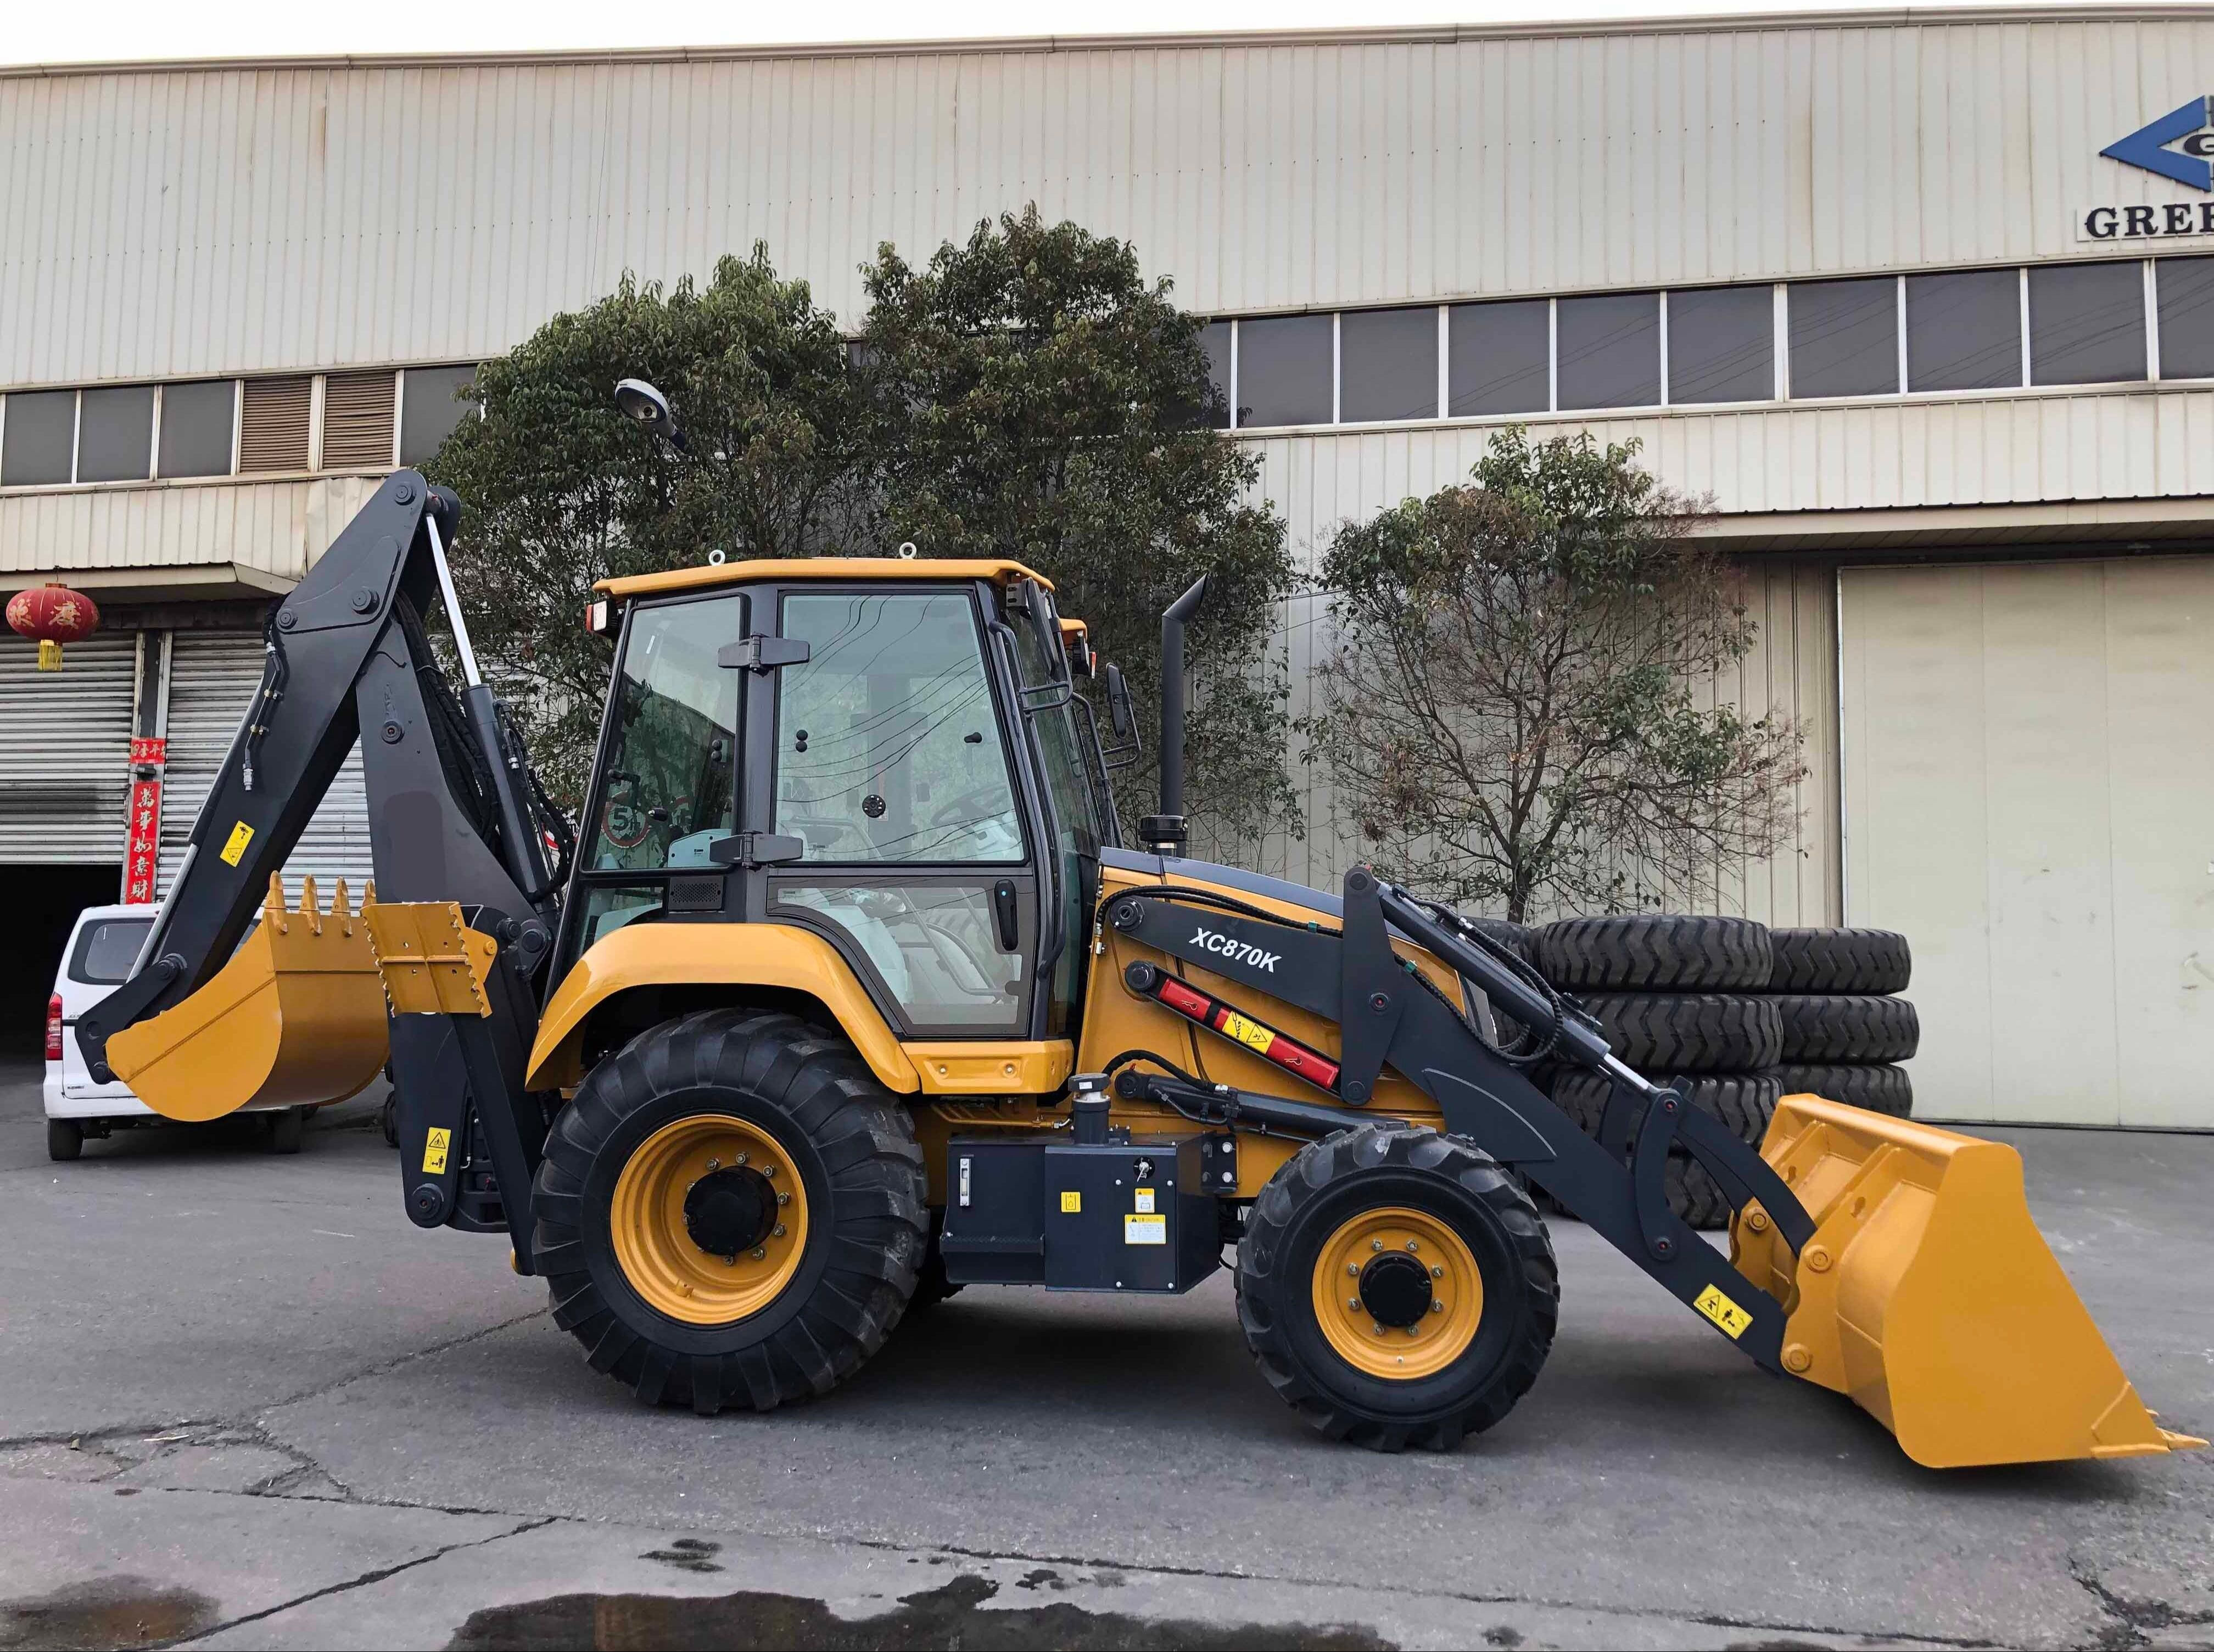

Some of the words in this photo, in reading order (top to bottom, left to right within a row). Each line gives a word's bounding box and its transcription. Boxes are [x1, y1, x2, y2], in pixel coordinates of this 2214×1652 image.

[130, 786, 155, 904] 萬事如意財
[1189, 927, 1282, 973] XC870K
